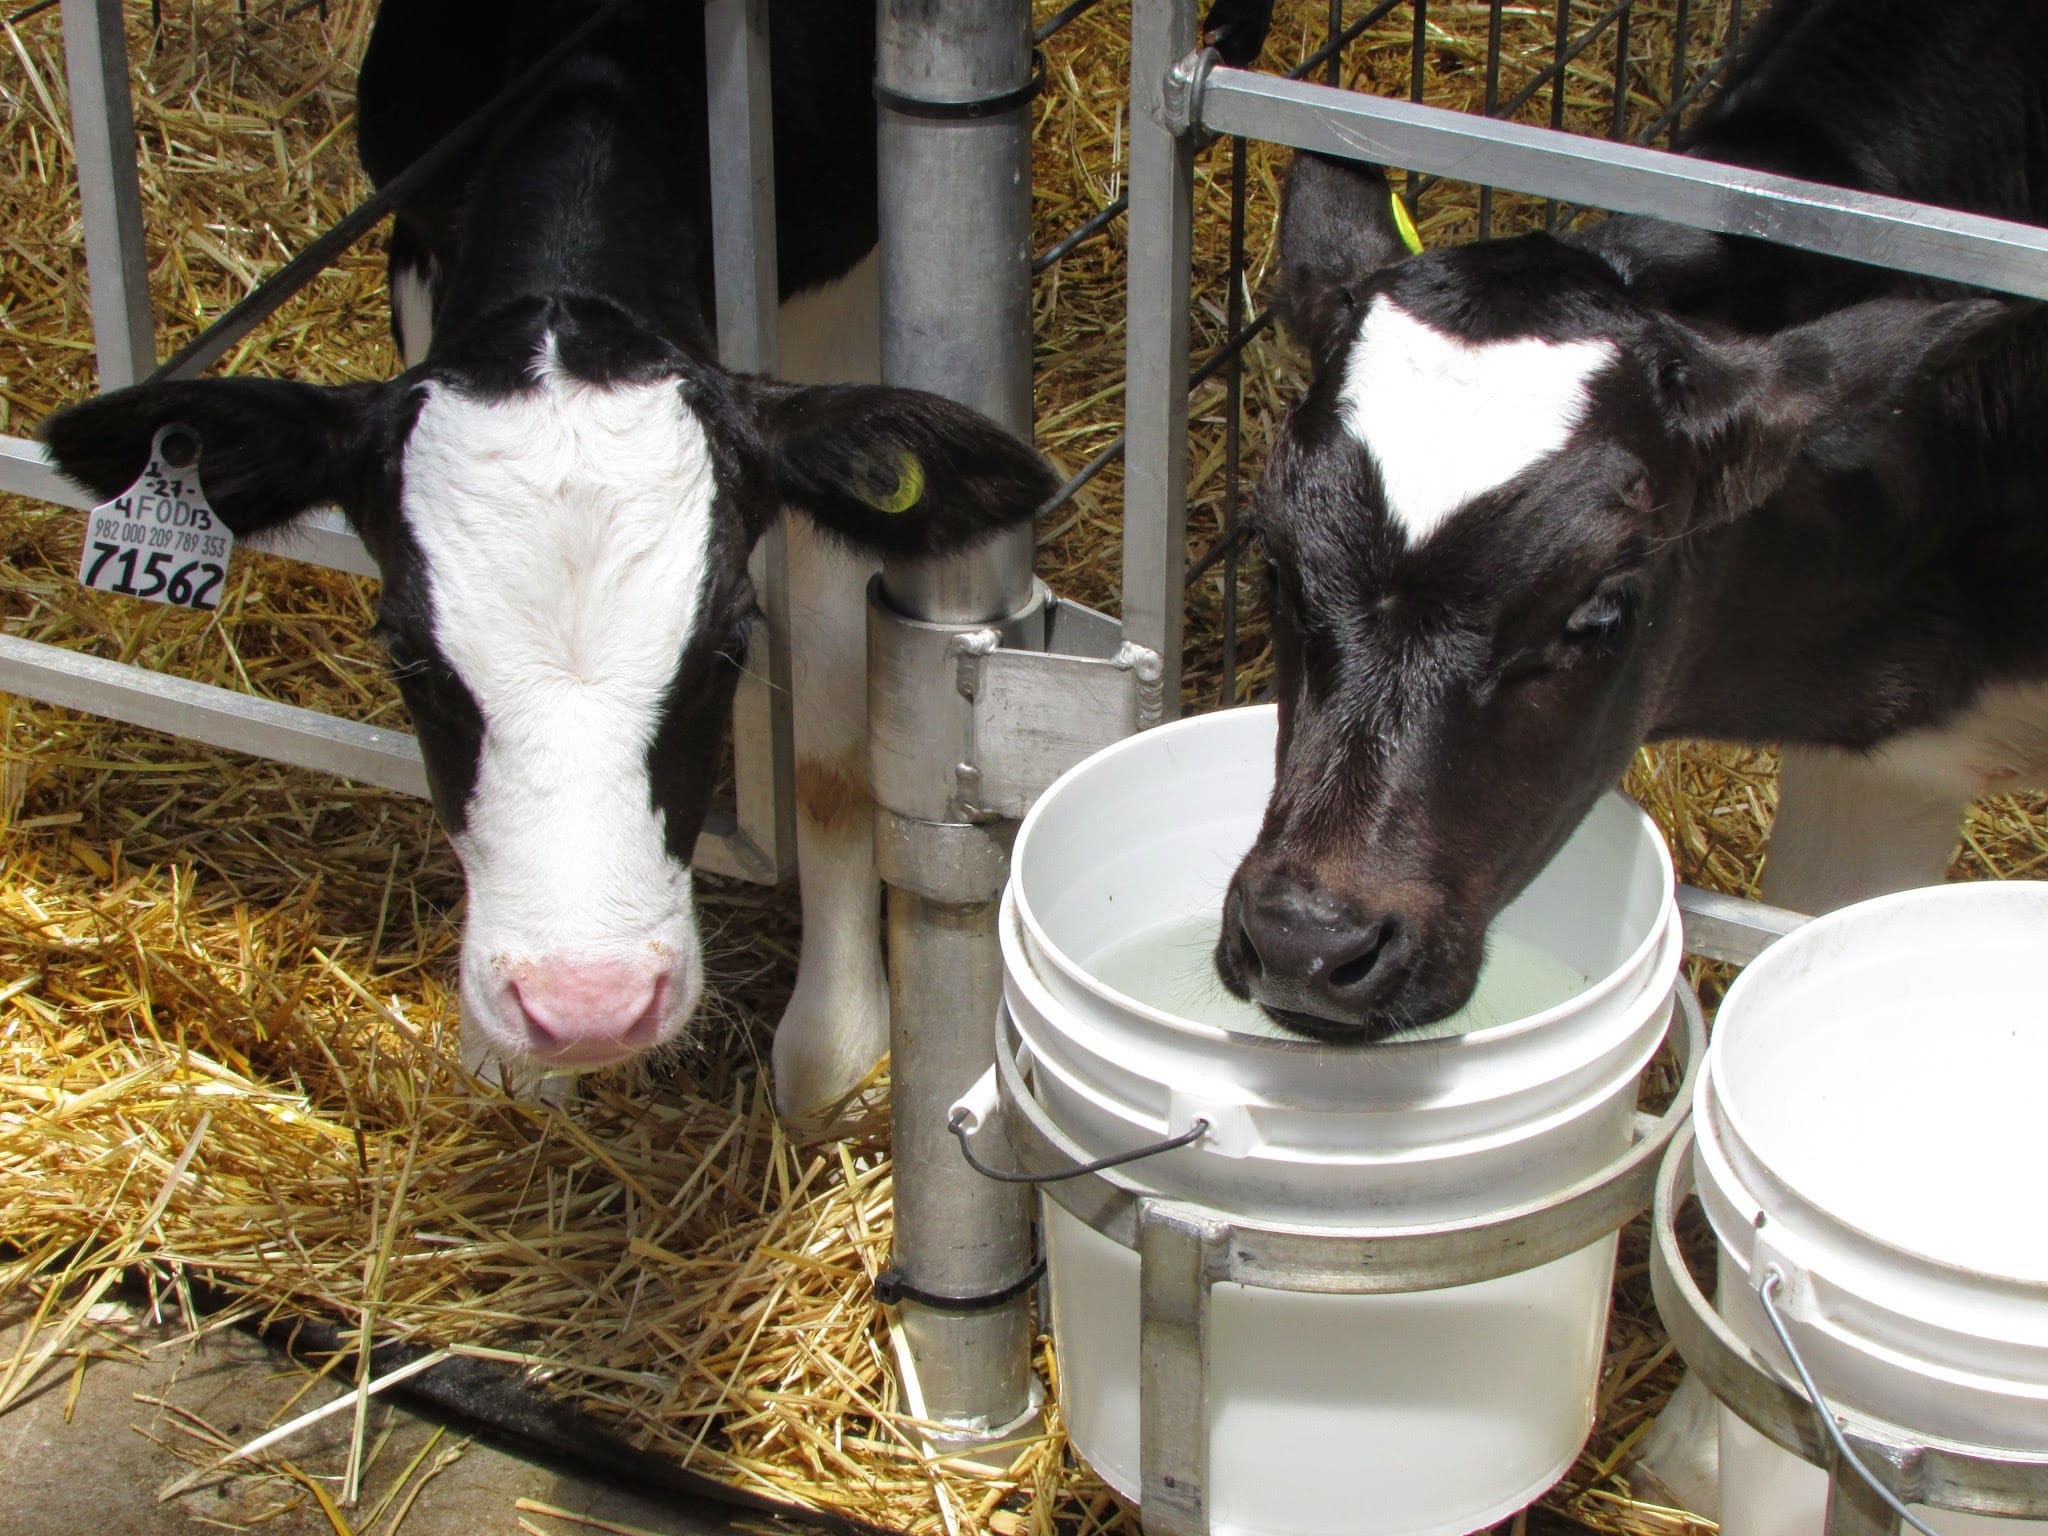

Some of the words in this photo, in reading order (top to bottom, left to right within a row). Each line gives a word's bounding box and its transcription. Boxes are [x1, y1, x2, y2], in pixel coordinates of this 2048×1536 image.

[95, 518, 119, 540] 982
[122, 523, 146, 544] 000
[148, 528, 173, 549] 209
[174, 532, 199, 553] 789
[201, 535, 227, 558] 353
[85, 541, 225, 610] 71562
